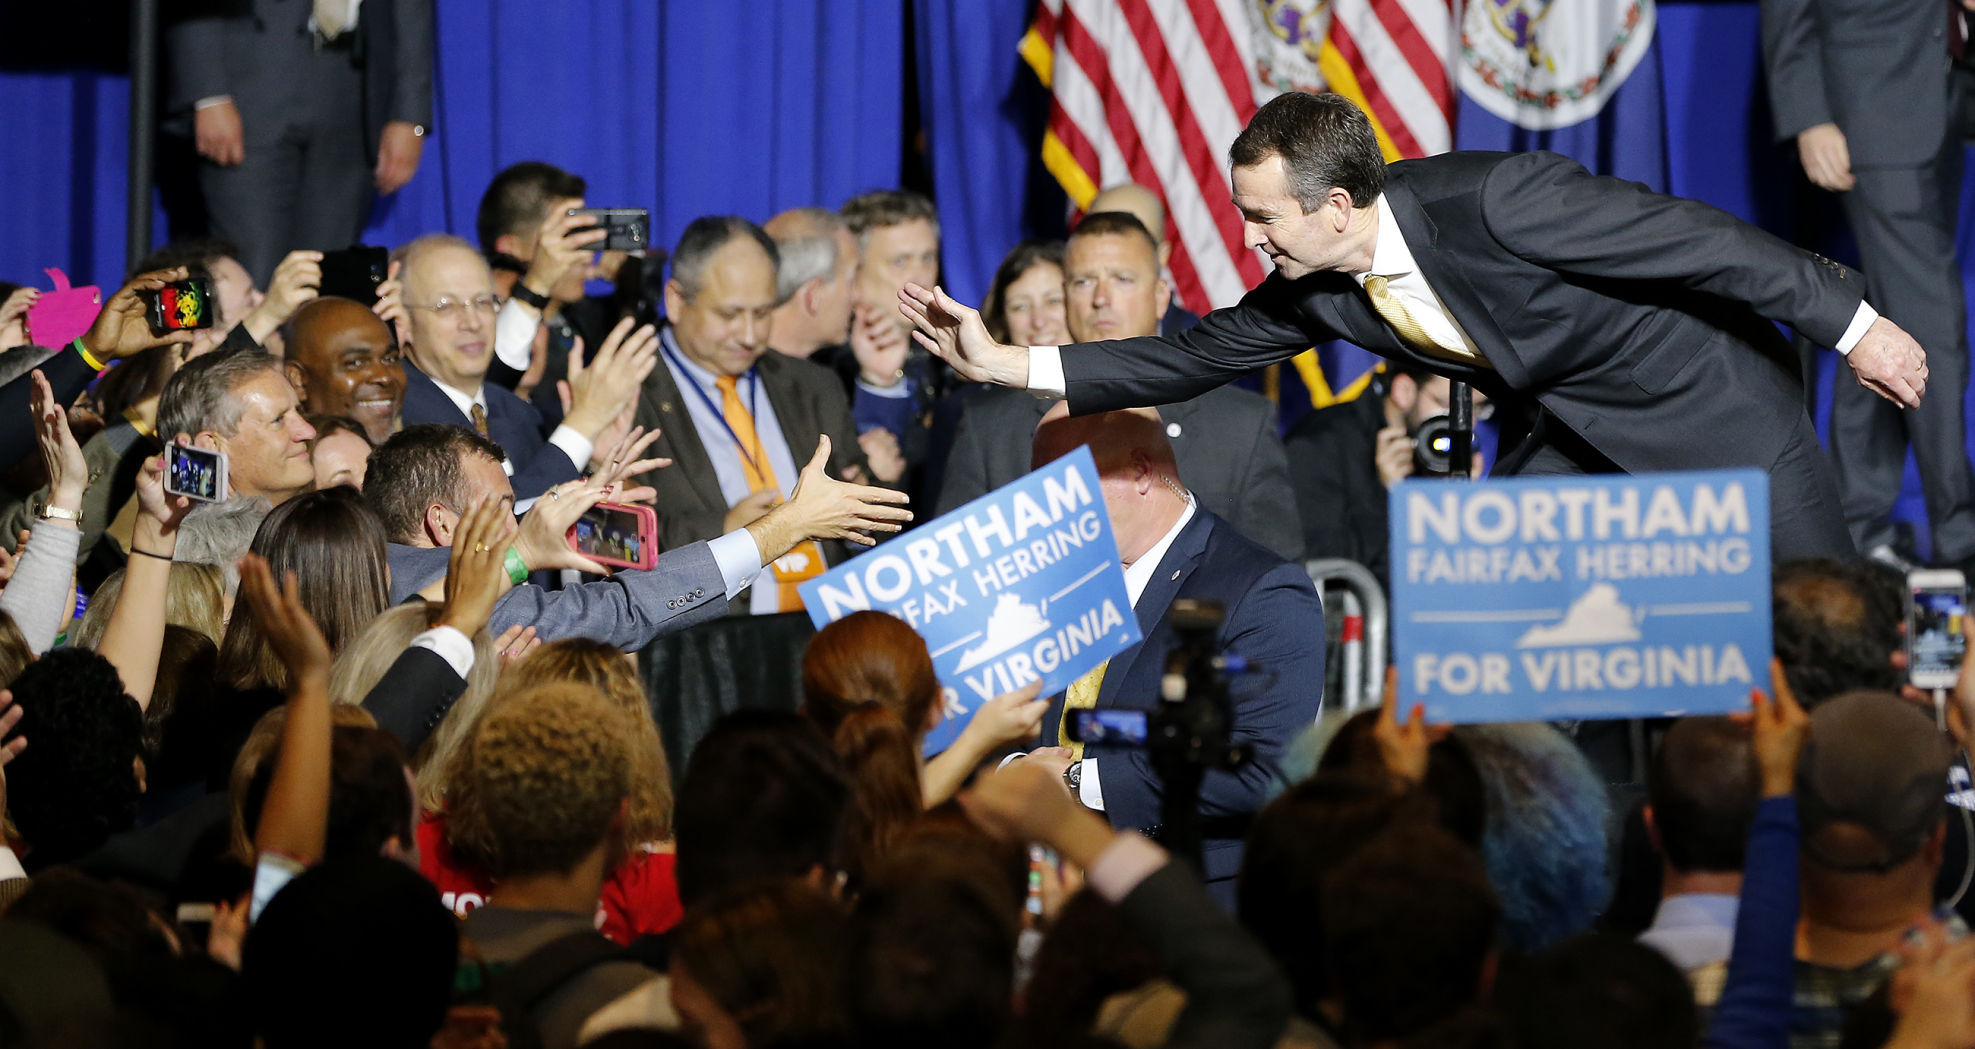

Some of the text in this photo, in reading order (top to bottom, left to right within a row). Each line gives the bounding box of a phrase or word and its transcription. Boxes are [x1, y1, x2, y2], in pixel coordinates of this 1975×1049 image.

[818, 465, 1094, 622] NORTHAM
[1407, 483, 1752, 545] NORTHAM
[973, 512, 1102, 597] HERRING
[1407, 538, 1752, 584] FAIRFAX HERRING
[964, 598, 1125, 702] VIRGINIA
[1413, 644, 1753, 695] FOR VIRGINIA
